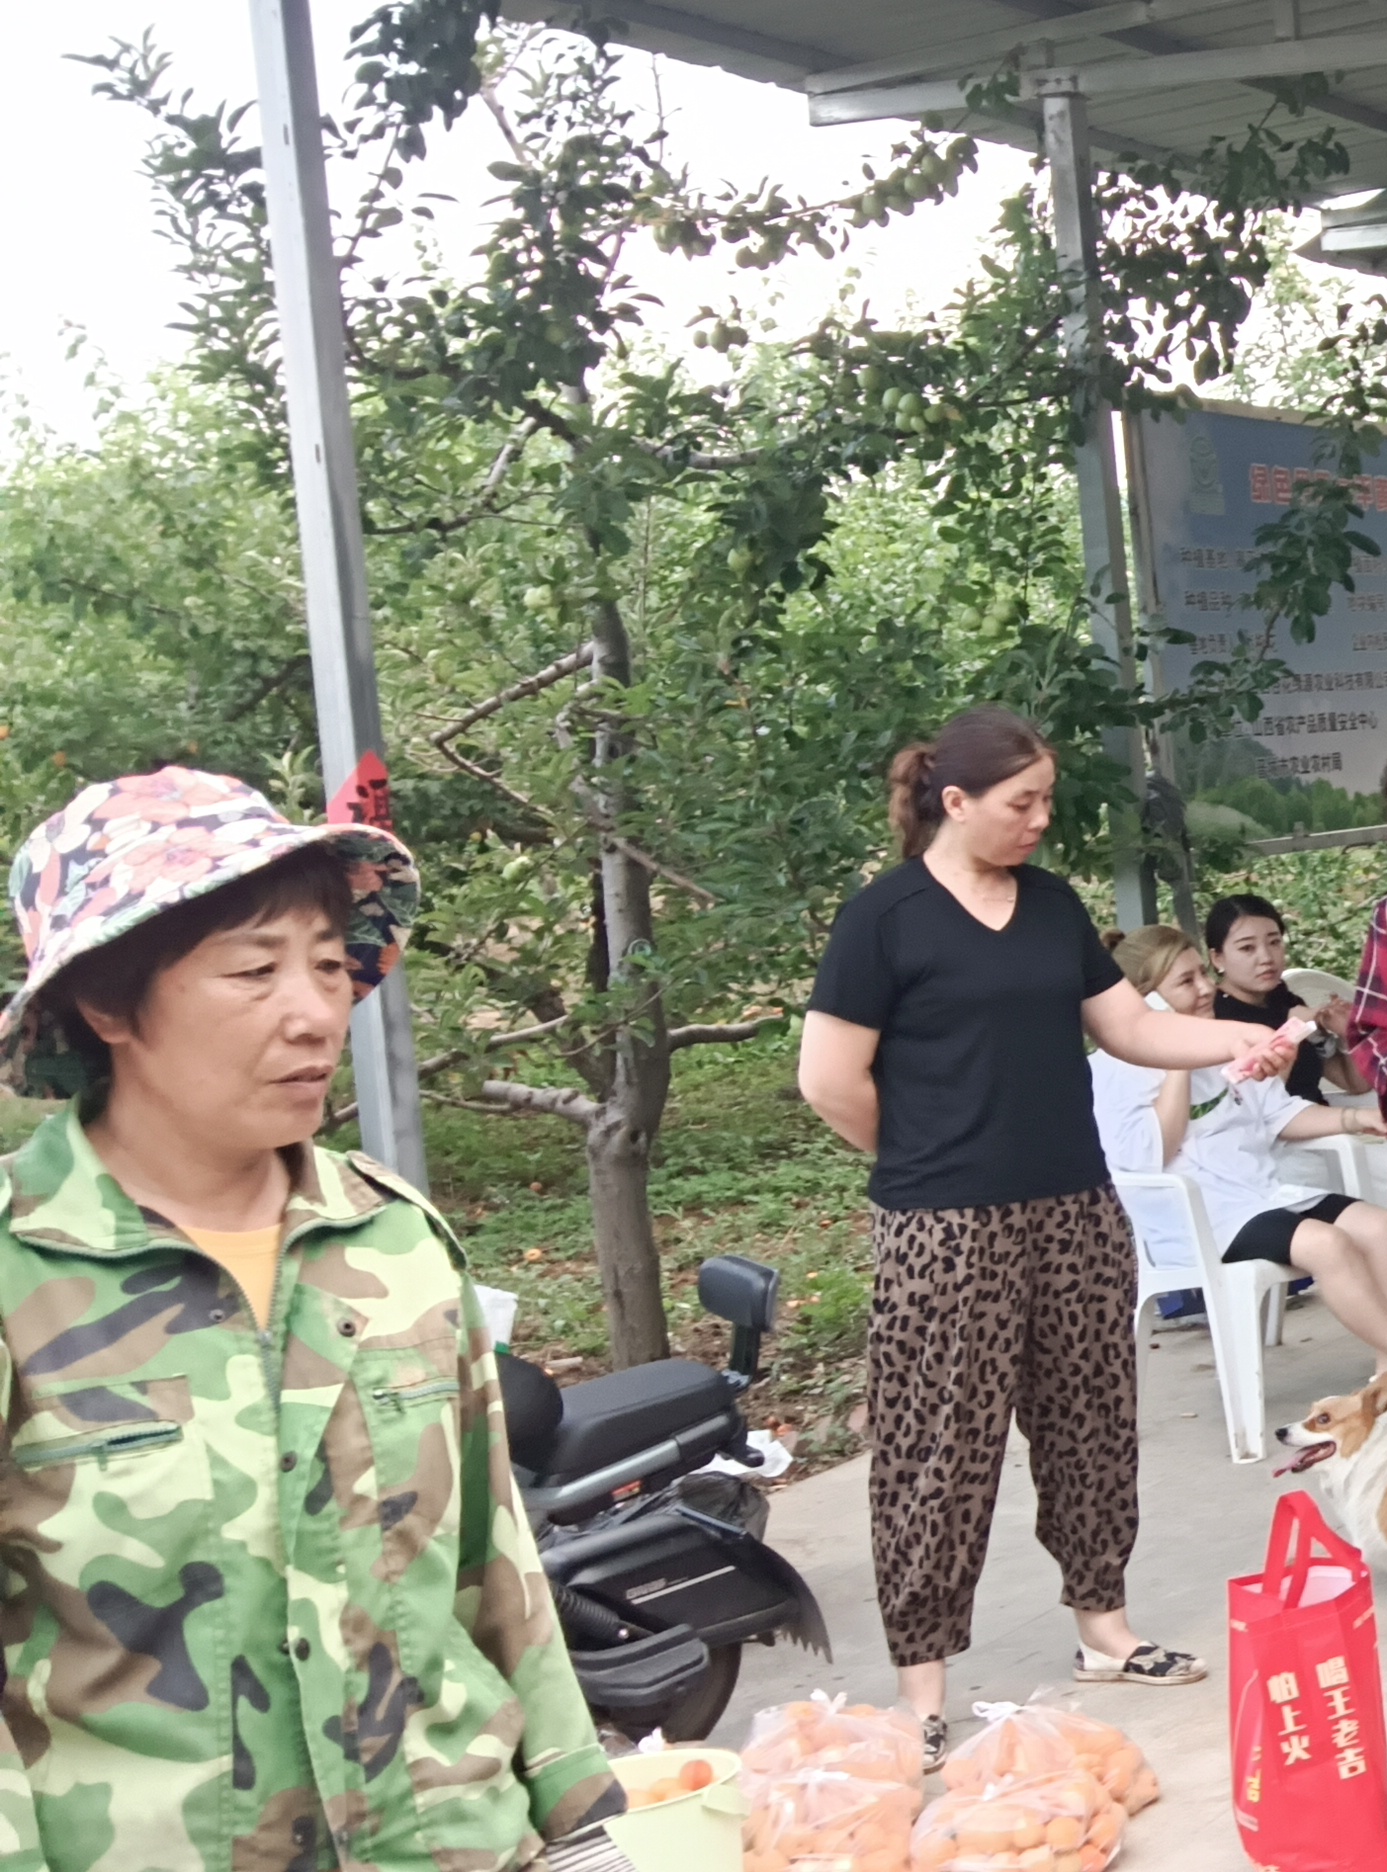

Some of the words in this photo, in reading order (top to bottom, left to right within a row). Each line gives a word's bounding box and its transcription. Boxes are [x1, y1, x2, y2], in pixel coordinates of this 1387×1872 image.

[1266, 1671, 1312, 1766] 怕上火
[1315, 1655, 1368, 1781] 喝王老吉
